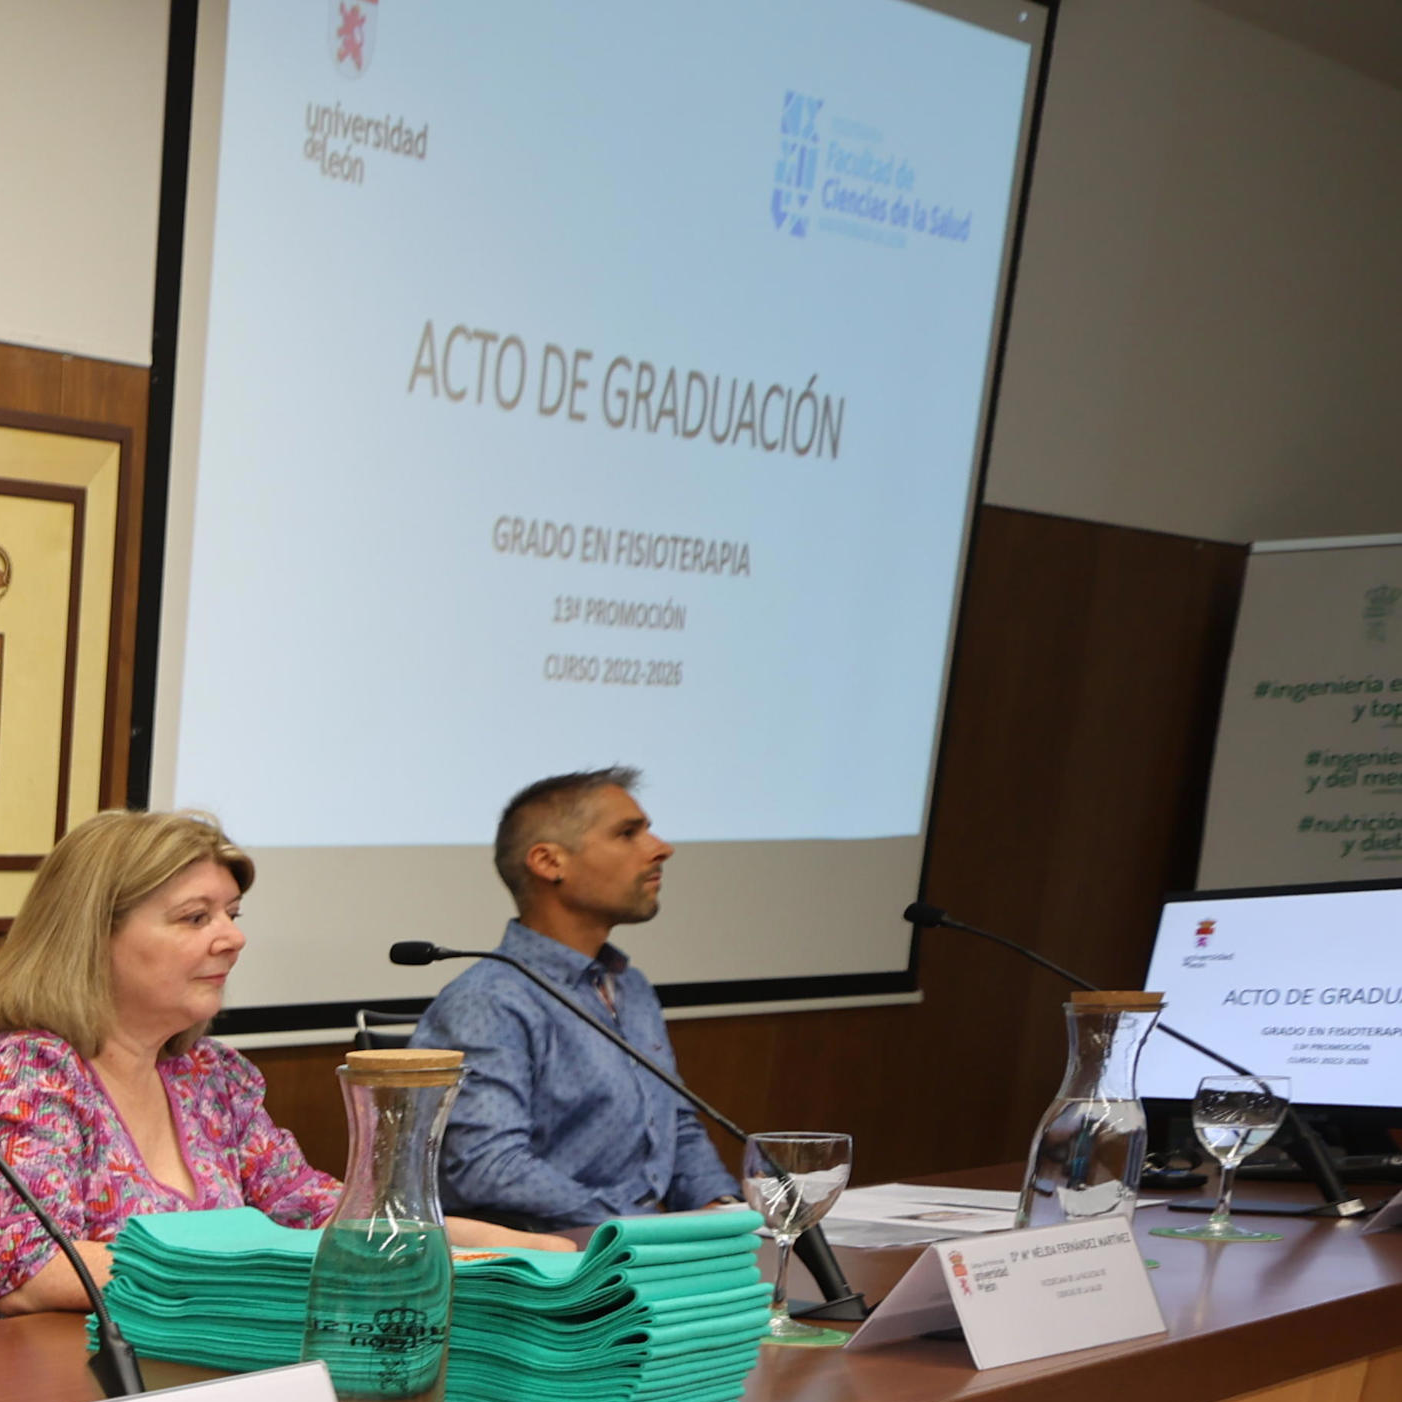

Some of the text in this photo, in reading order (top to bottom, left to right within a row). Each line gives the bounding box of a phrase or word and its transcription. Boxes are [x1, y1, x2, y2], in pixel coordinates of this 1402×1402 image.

[306, 101, 429, 160] universidad
[321, 143, 364, 185] león
[822, 177, 888, 221] Ciencias
[890, 194, 909, 227] de
[912, 198, 927, 232] la
[929, 205, 973, 242] Salud
[408, 320, 845, 459] ACTO DE GRADUACIÓN
[492, 515, 750, 576] GRADO EN FISIOTERAPIA
[584, 597, 686, 630] PROMOCIÓN
[544, 653, 683, 686] CURSO 2022-2026
[1351, 704, 1366, 724] y
[1305, 775, 1321, 794] y
[1341, 840, 1356, 858] y
[1222, 987, 1402, 1006] ACTO DE GRADU
[1261, 1026, 1305, 1037] GRADO
[1307, 1027, 1325, 1036] EN
